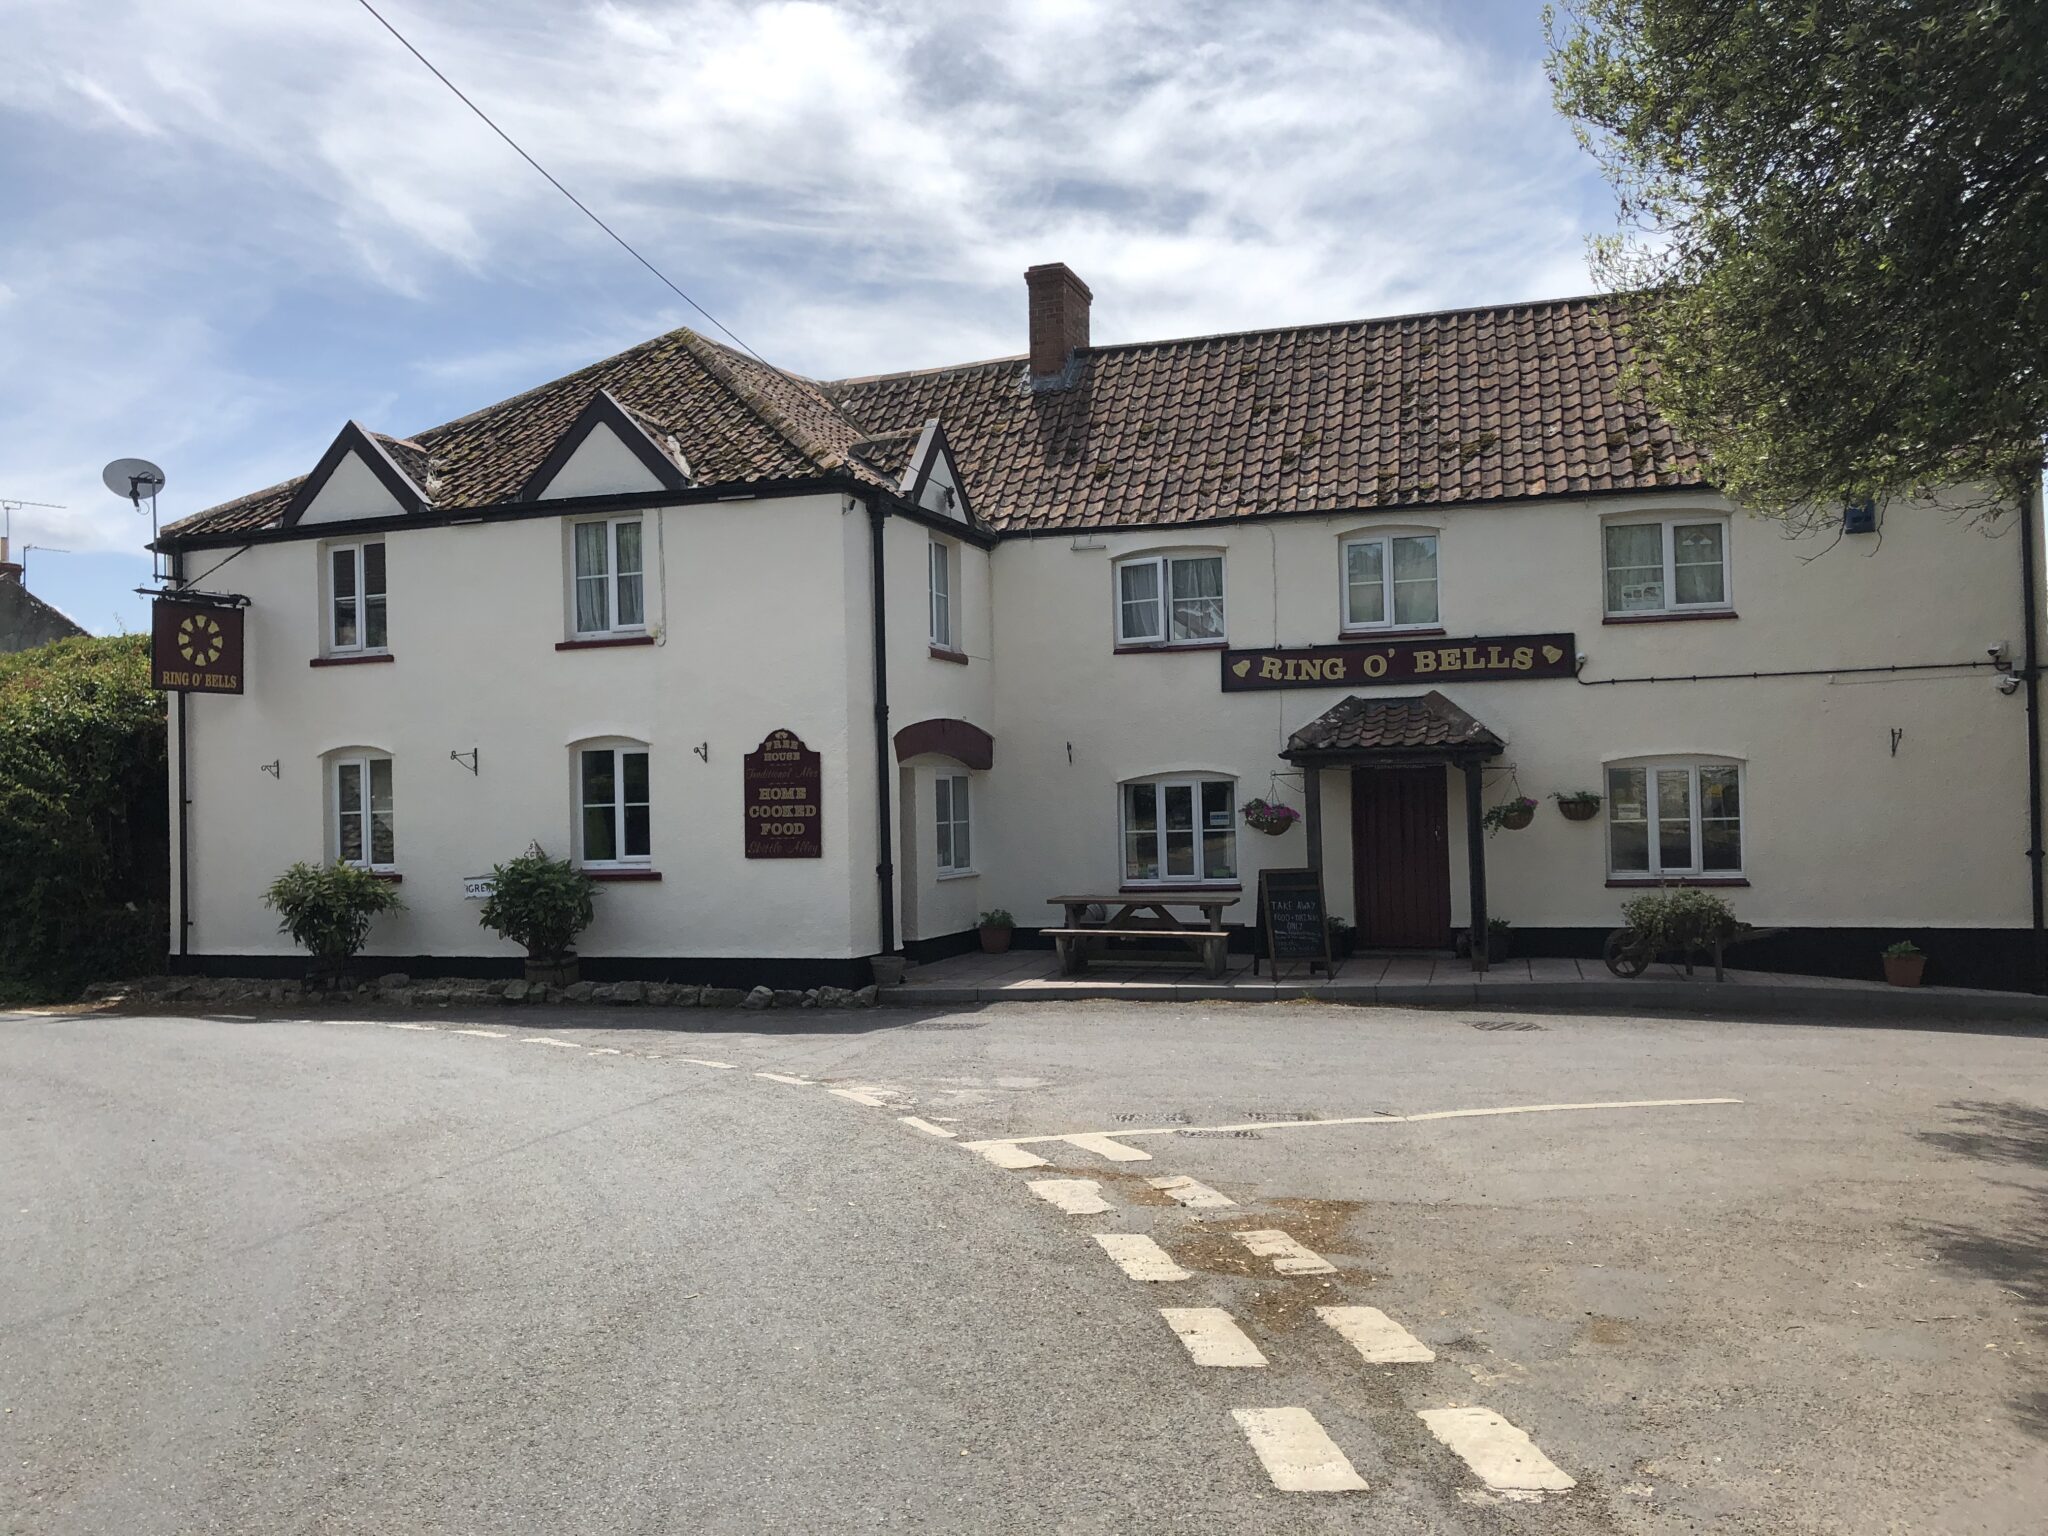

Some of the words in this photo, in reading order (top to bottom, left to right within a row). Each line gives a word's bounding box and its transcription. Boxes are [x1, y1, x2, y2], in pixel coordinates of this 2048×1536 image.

[1258, 656, 1346, 681] RING
[1363, 648, 1396, 678] O'
[1413, 646, 1534, 673] BELLS
[163, 672, 189, 685] RING
[192, 673, 203, 687] O'
[205, 673, 237, 688] BELLS
[764, 740, 799, 750] FREE
[764, 752, 800, 761] HOUSE
[759, 787, 806, 799] HOME
[748, 805, 817, 818] COOKED
[760, 823, 805, 835] FOOD
[1270, 901, 1294, 911] TAKE
[1297, 901, 1316, 910] AWAY
